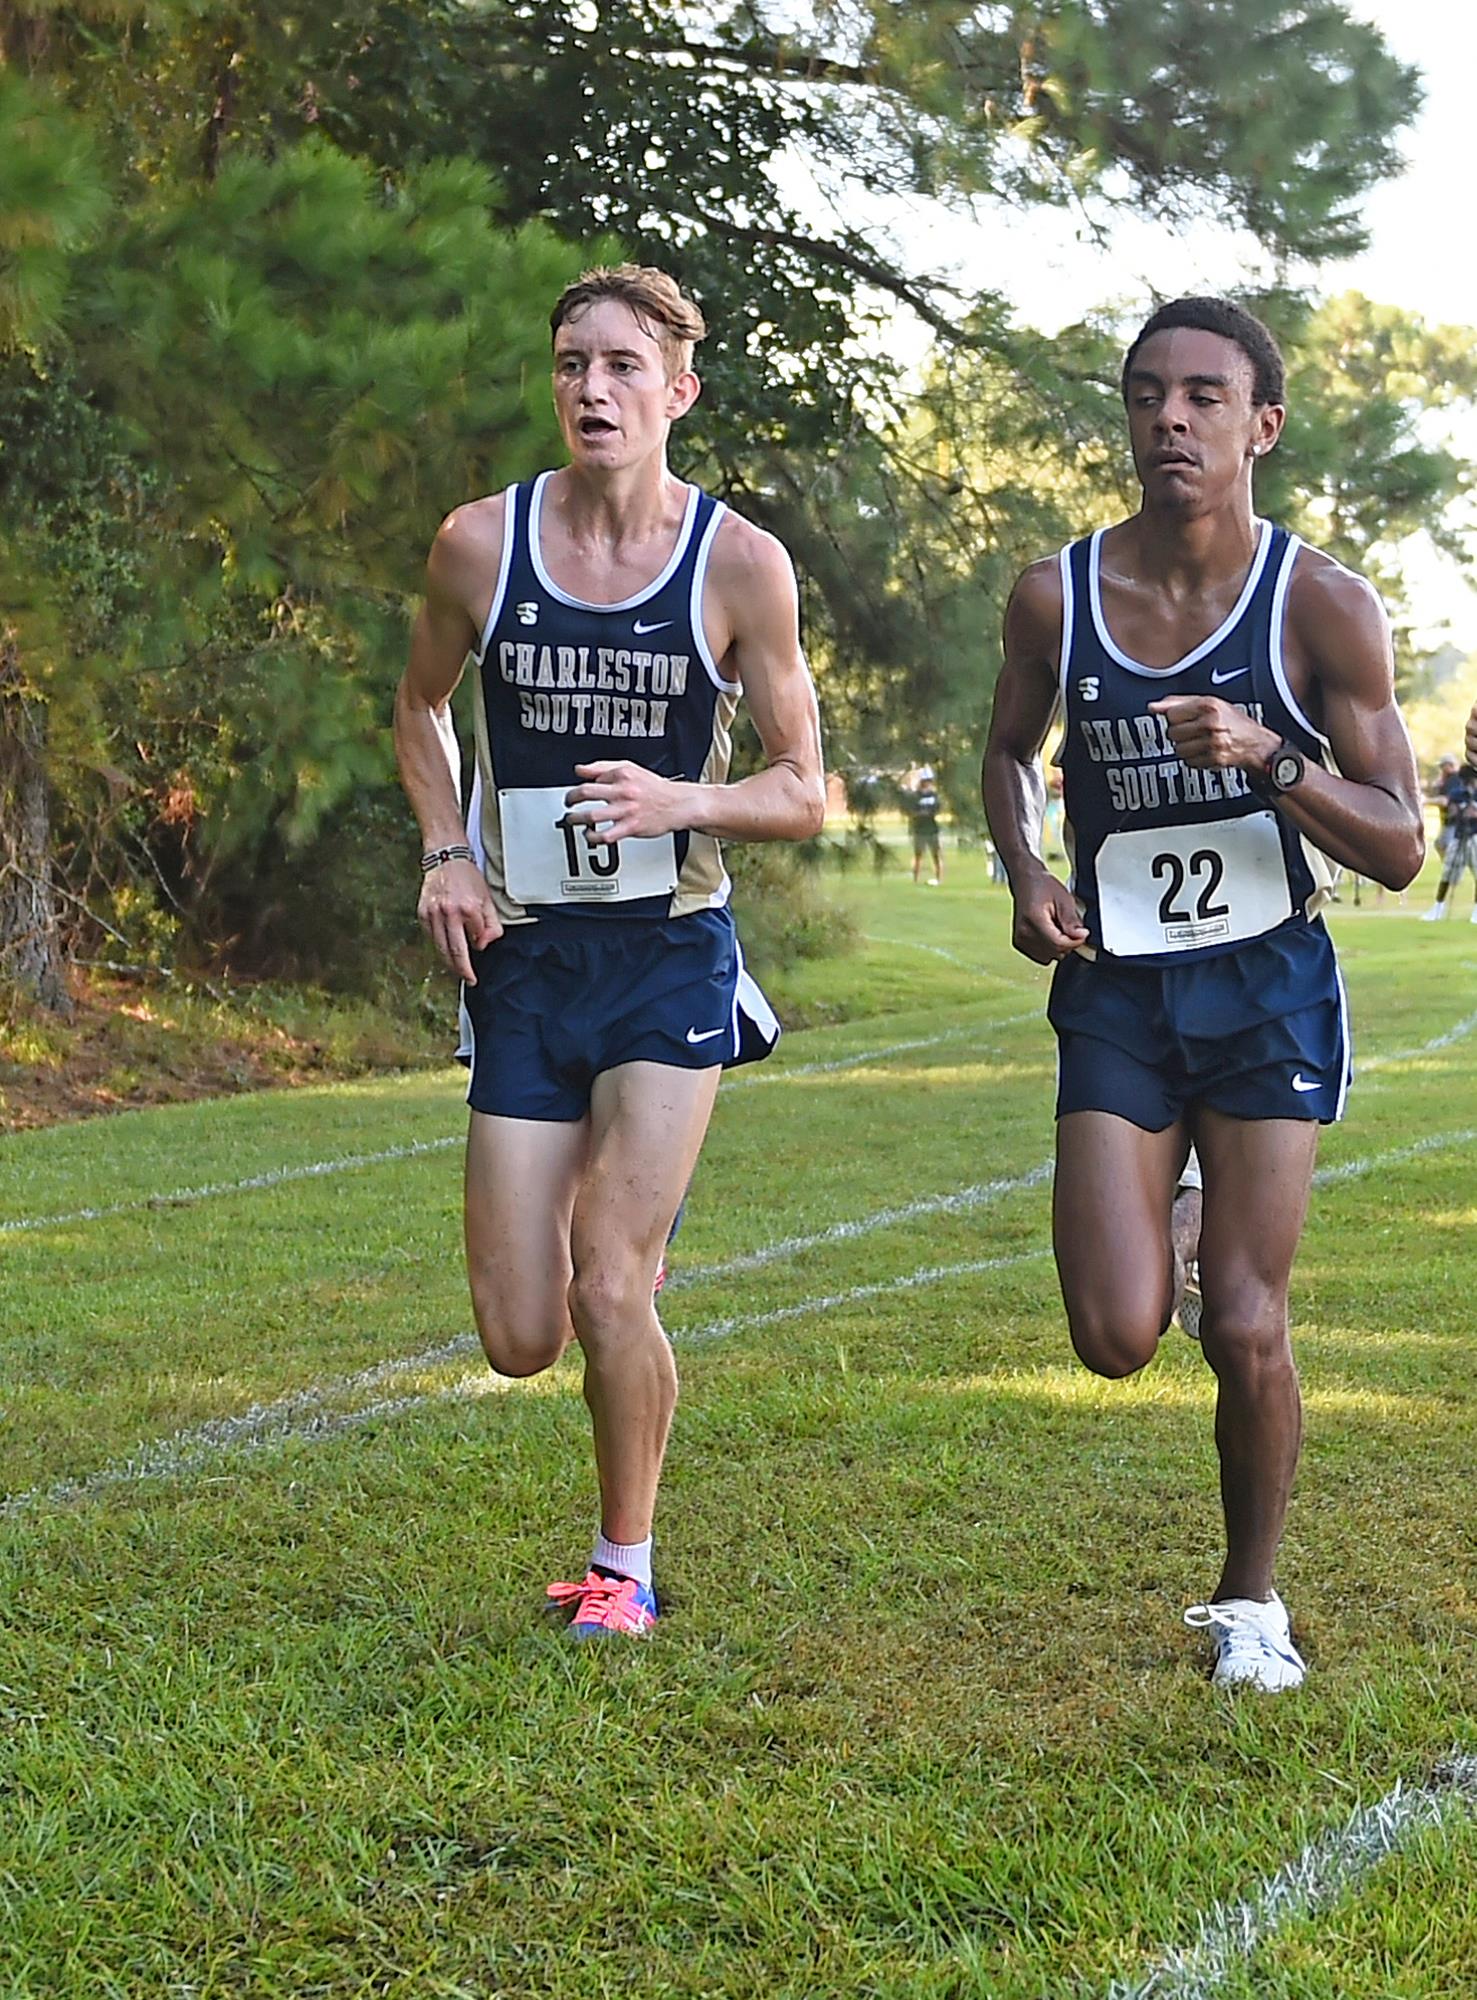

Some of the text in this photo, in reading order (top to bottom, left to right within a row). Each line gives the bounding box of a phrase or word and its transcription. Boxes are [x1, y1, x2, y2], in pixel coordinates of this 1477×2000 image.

[499, 641, 690, 696] CHARLESTON
[519, 691, 669, 737] SOUTHERN
[1151, 849, 1229, 924] 22
